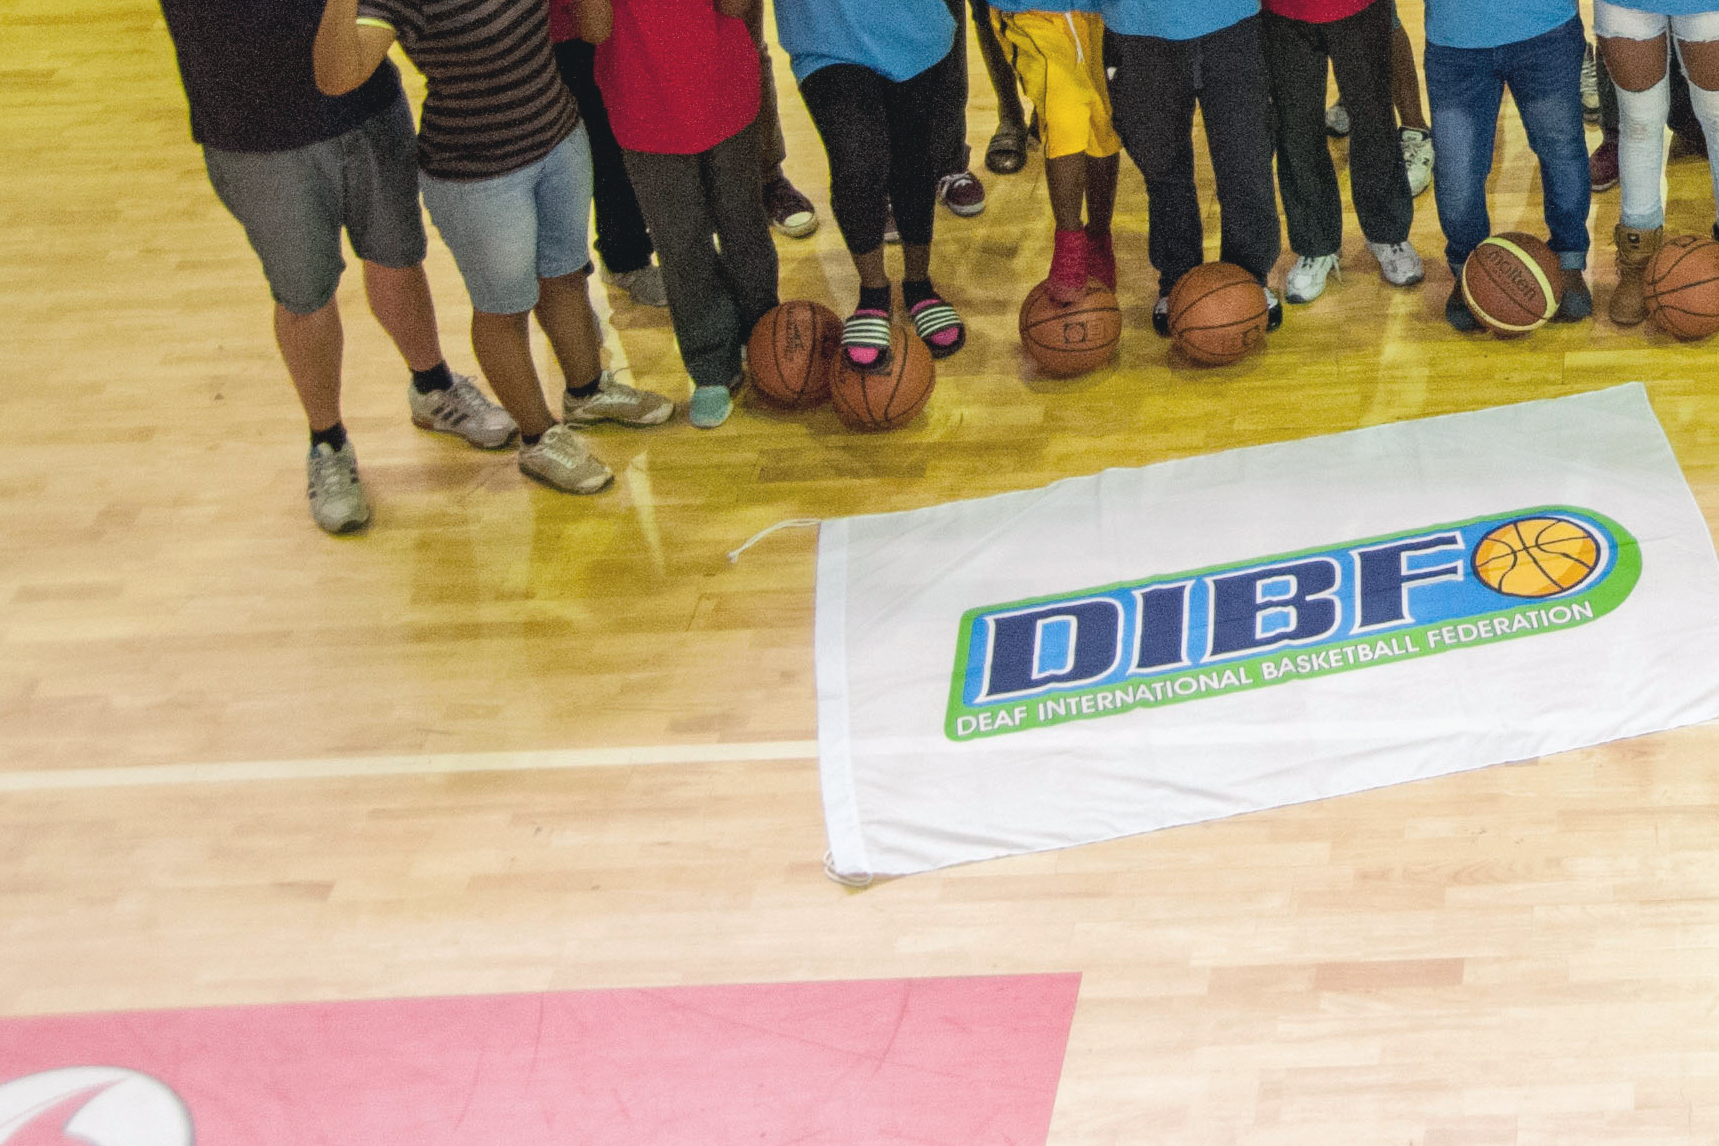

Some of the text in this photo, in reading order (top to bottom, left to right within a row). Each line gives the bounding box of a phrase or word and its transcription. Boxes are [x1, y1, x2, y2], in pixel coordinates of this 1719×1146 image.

[956, 600, 1595, 739] DEAF INTERNATIONAL BASKETBALL FEDERATION
[975, 531, 1466, 706] DIBF
